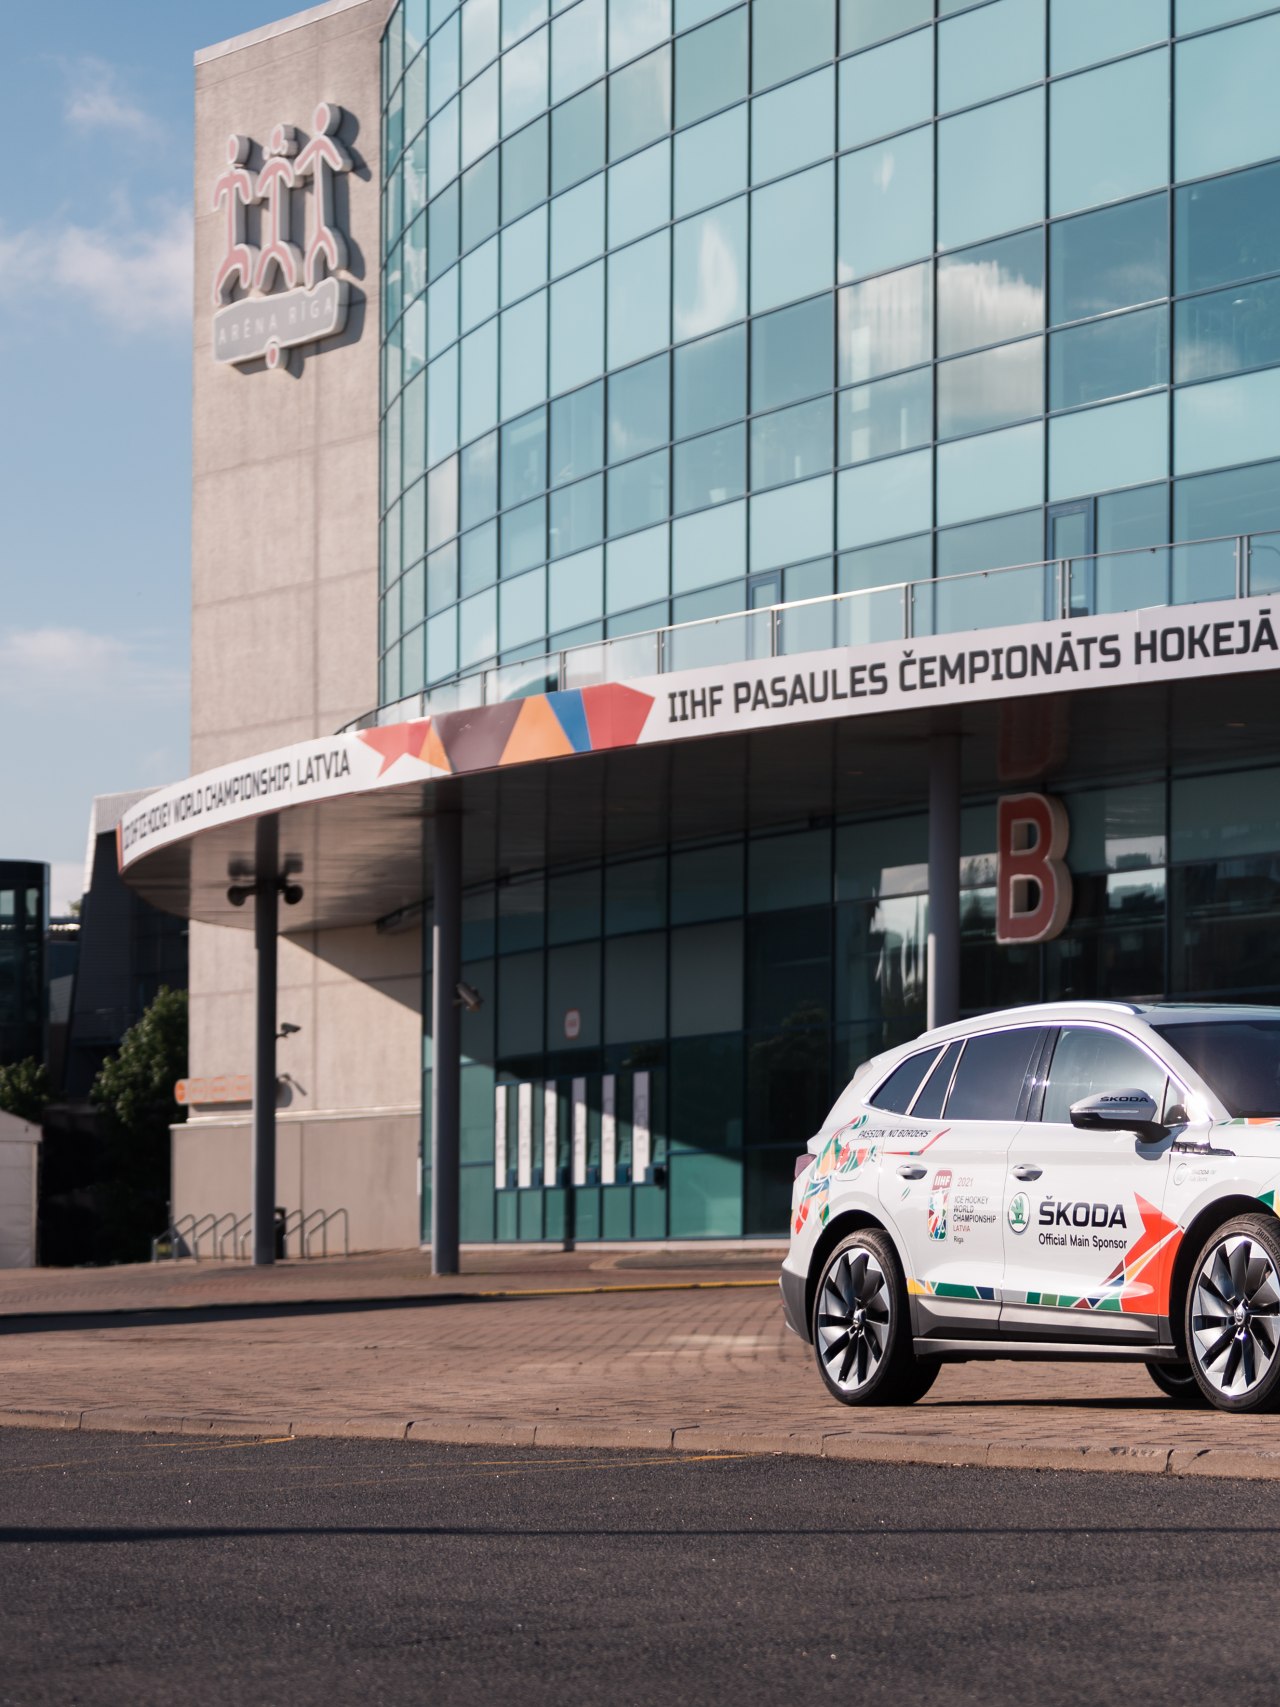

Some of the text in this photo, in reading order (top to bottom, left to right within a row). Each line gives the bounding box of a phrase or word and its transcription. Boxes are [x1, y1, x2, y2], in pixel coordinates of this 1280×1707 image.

[668, 684, 724, 723] IIHF
[733, 662, 888, 713] PASAULES
[899, 631, 1121, 692] ČEMPIONĀTS
[1134, 608, 1278, 665] HOKEJĀ
[173, 787, 202, 825] WORLD
[205, 762, 293, 812] CHAMPIONSHIP,
[297, 748, 351, 786] LATVIA
[996, 792, 1066, 944] B
[887, 1129, 900, 1138] NO
[957, 1177, 974, 1187] 2021
[954, 1195, 989, 1205] ICE HOCKEY
[953, 1205, 974, 1214] WORLD
[1038, 1195, 1128, 1229] ŠKODA
[952, 1214, 997, 1224] CHAMPIONSHIP
[953, 1224, 971, 1232] LATVIA
[953, 1235, 964, 1244] Riga
[1038, 1232, 1128, 1251] Official Main Sponsor
